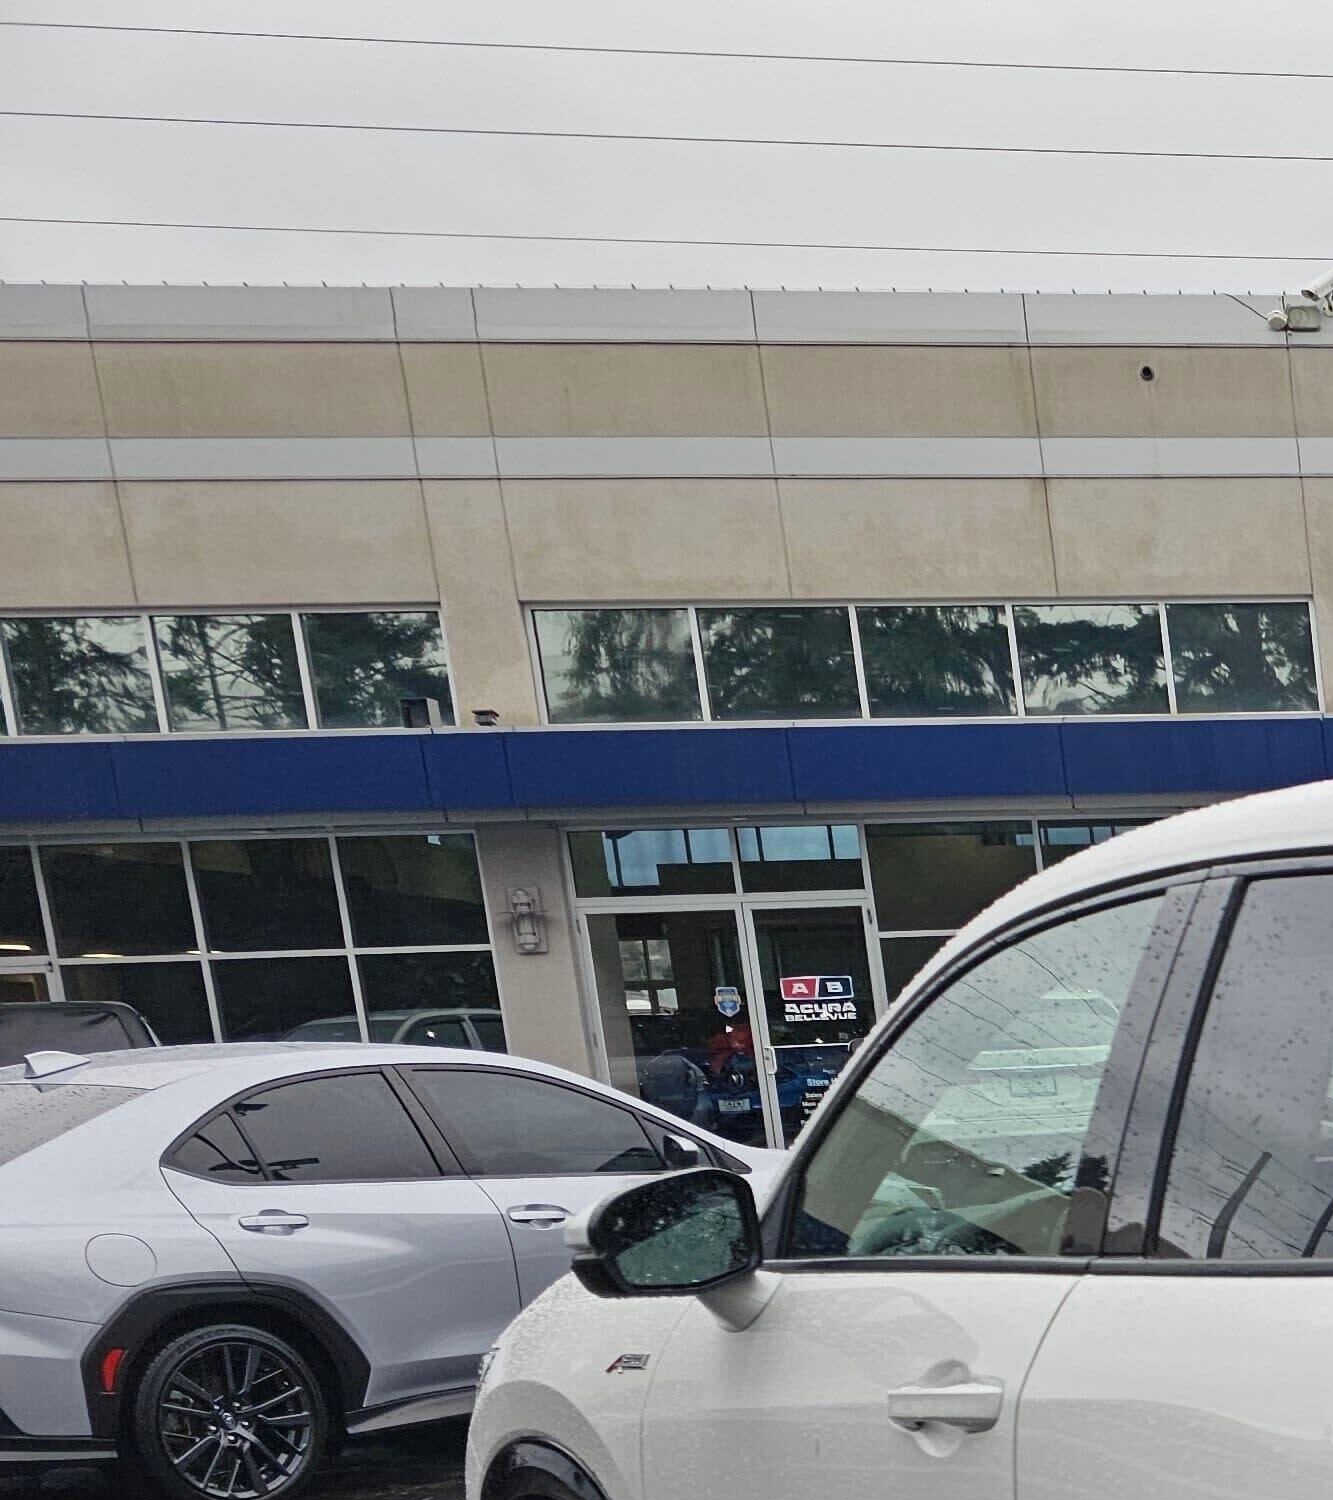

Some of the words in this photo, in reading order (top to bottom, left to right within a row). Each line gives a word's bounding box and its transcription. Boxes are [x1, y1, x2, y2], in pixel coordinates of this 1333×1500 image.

[791, 982, 809, 995] A
[825, 981, 844, 993] B
[784, 1002, 857, 1014] ACURA
[784, 1012, 857, 1022] BELLEVUE
